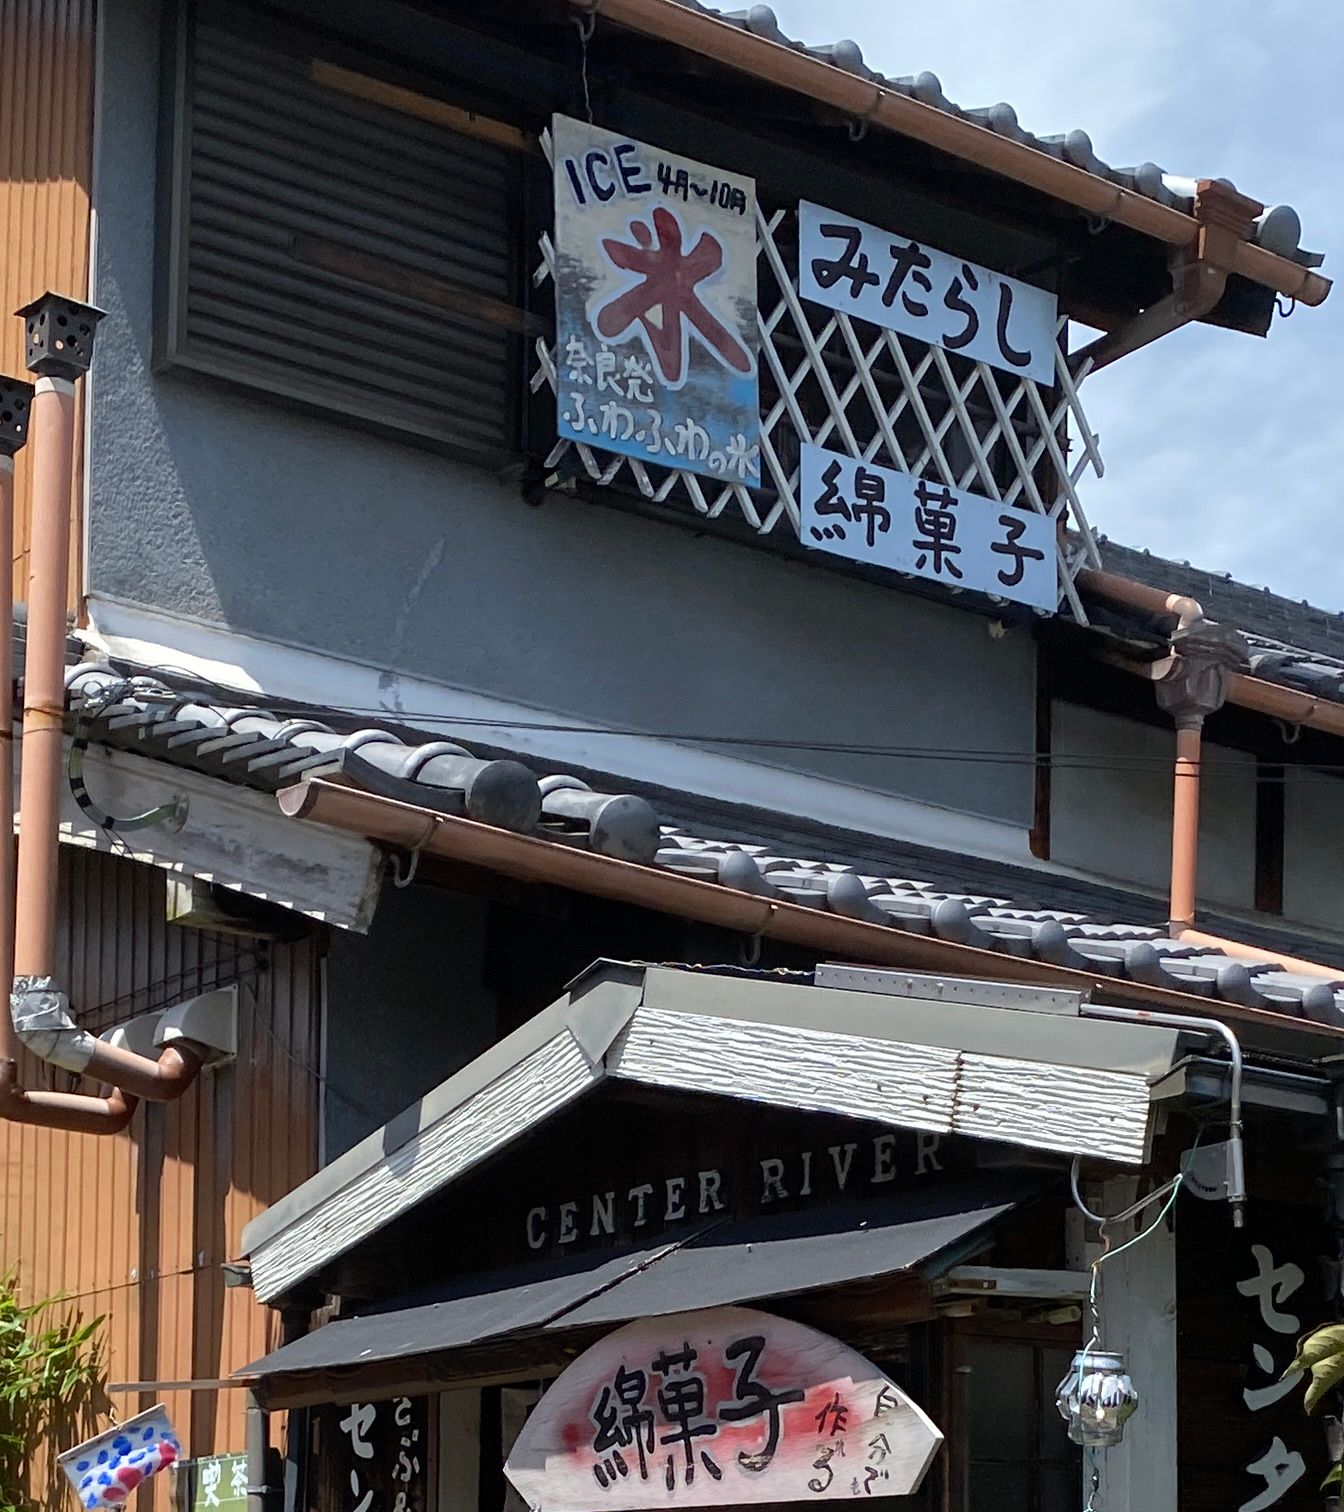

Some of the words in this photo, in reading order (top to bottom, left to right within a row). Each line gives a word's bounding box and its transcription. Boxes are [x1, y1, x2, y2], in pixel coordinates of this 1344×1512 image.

[565, 144, 651, 204] ICE
[598, 207, 752, 382] 氷
[812, 224, 1031, 366] みたらし
[811, 460, 1044, 587] 綿菓子
[525, 1169, 724, 1249] CENTER
[761, 1130, 945, 1203] RIVER
[593, 1335, 805, 1490] 綿菓子
